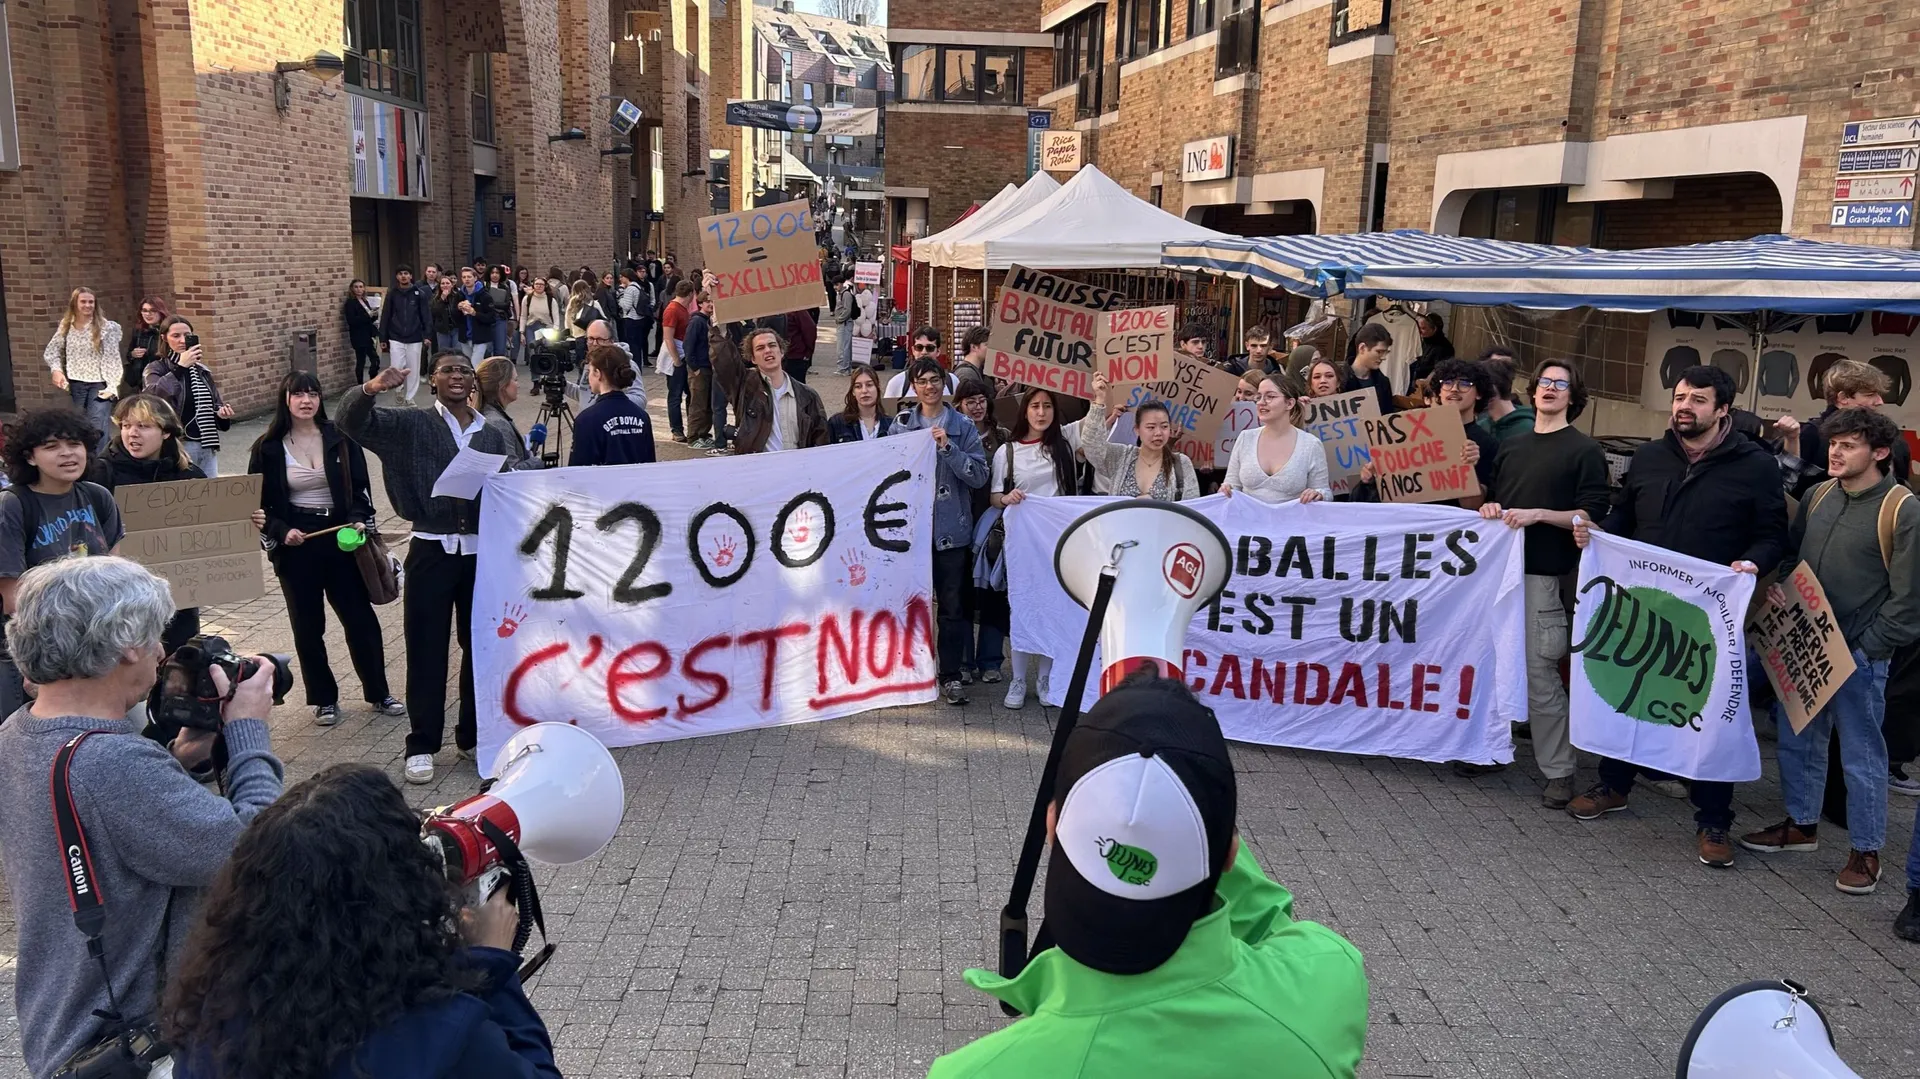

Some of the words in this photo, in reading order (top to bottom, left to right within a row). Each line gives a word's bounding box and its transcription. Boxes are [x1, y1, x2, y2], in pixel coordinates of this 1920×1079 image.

[1053, 136, 1075, 146] Rice
[1861, 133, 1883, 141] humaines
[1862, 123, 1878, 132] Secteur
[1888, 121, 1905, 129] sciences
[1046, 144, 1077, 157] Paper
[1050, 154, 1075, 167] Rolls
[1187, 150, 1207, 173] ING
[1835, 208, 1844, 223] P
[1849, 215, 1891, 225] Grand-place
[1850, 205, 1866, 214] Aula
[1868, 206, 1893, 216] Magna
[716, 260, 820, 298] EXCLUSION
[1012, 268, 1126, 312] HAUSSE
[1001, 291, 1094, 341] BRUTAL
[1109, 308, 1169, 334] 1200€
[1014, 328, 1092, 368] FUTUR
[1104, 333, 1165, 355] C'EST
[993, 351, 1094, 399] BANCAL
[1108, 353, 1158, 383] NON
[1127, 386, 1202, 432] SAAIRE
[1184, 387, 1218, 415] TON
[1305, 396, 1366, 424] UNIF
[1223, 408, 1261, 432] 12
[1304, 417, 1360, 443] 'EST
[1364, 413, 1407, 446] PAS
[1370, 438, 1448, 476] TOUCHE
[1393, 471, 1423, 497] NOS
[165, 503, 207, 527] EST
[142, 534, 168, 557] UN
[180, 522, 238, 553] DROIT
[1235, 529, 1479, 581] BALLES
[174, 562, 200, 576] DES
[179, 575, 200, 588] VOS
[1206, 590, 1317, 641] EST
[1338, 597, 1418, 644] UN
[1793, 572, 1821, 611] 1200
[1814, 610, 1835, 643] DE
[815, 592, 936, 696] NON
[1570, 575, 1712, 713] JEUNES
[1628, 558, 1694, 586] INFORMER
[1703, 586, 1737, 648] MOBILISER
[1720, 659, 1742, 723] DEFENDRE
[1771, 604, 1789, 627] JE
[1786, 626, 1823, 698] PREFERE
[1763, 612, 1779, 638] ME
[1796, 679, 1817, 716] UNE
[1767, 647, 1797, 702] BALLE
[1182, 649, 1476, 720] CANDALE!
[1647, 699, 1703, 732] CSC
[68, 844, 89, 895] Canon
[1099, 837, 1156, 880] JEUNES
[1128, 875, 1151, 887] CSC
